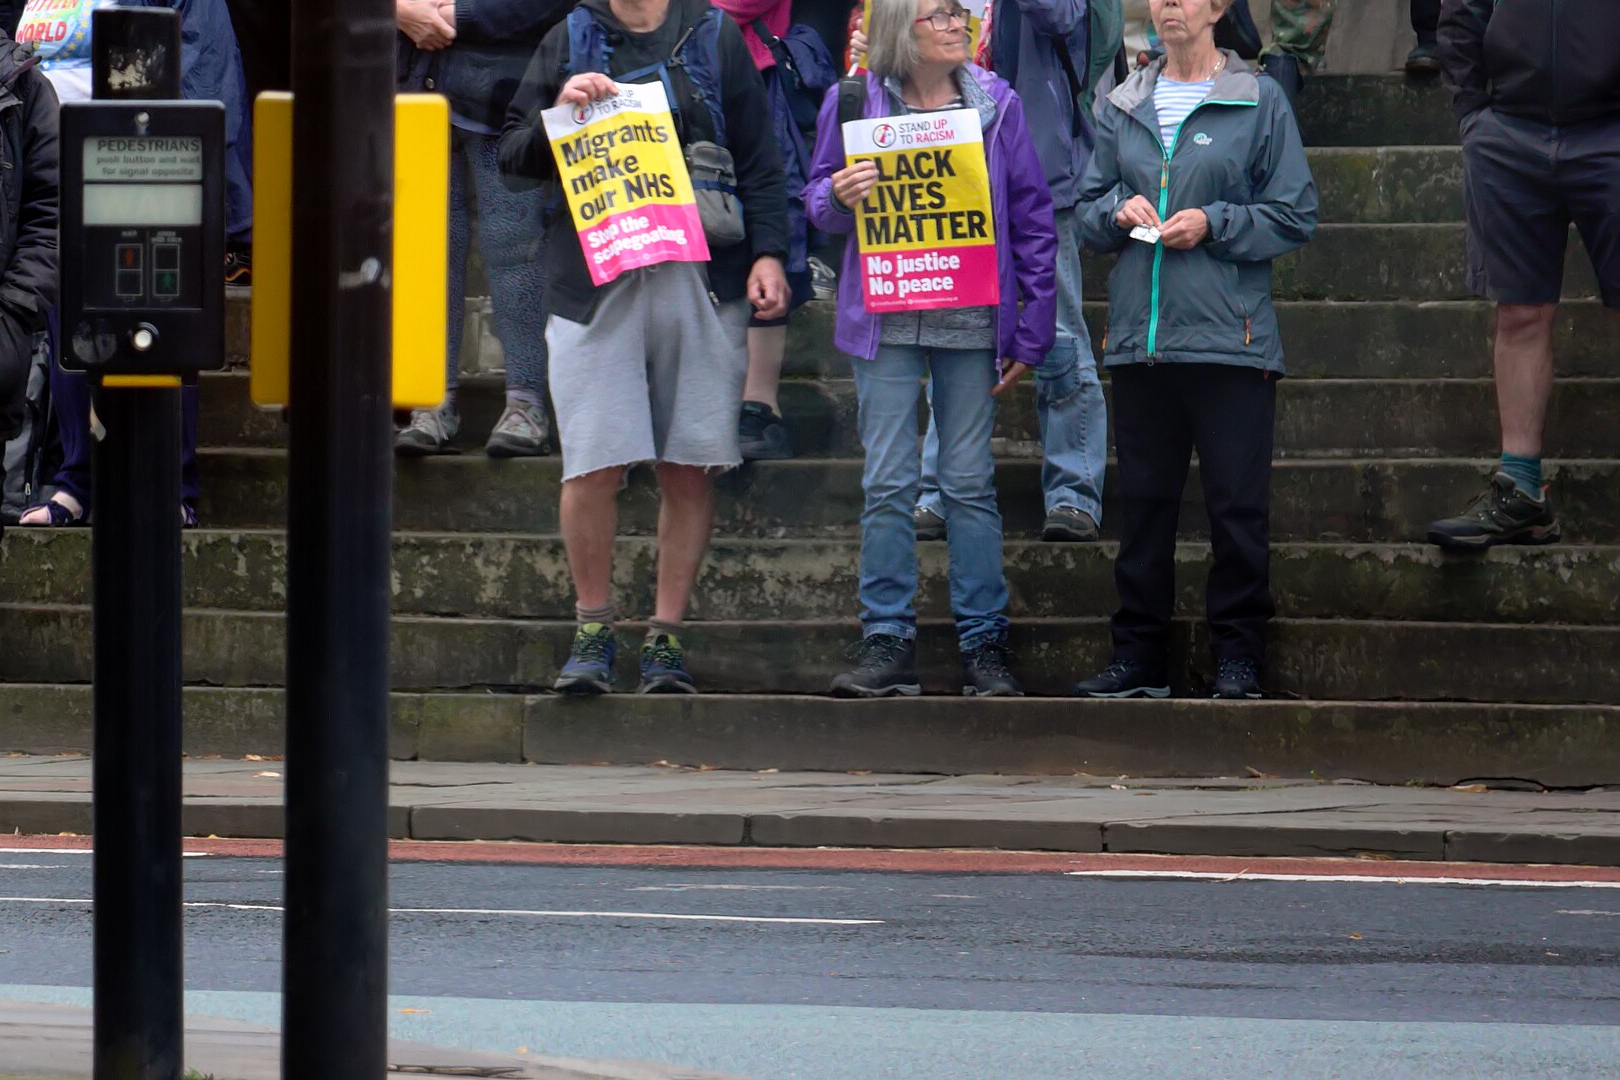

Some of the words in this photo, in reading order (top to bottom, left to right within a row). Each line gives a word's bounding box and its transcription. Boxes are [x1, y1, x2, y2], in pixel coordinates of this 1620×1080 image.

[899, 121, 931, 134] STAND
[934, 119, 948, 130] UP
[900, 135, 914, 145] TO
[916, 129, 955, 143] RACISM
[97, 139, 200, 152] PEDESTRIANS
[560, 120, 669, 167] Migrants
[123, 155, 156, 164] button
[855, 149, 956, 182] LACK
[571, 155, 639, 195] make
[580, 189, 618, 220] our
[623, 173, 675, 202] NHS
[587, 223, 619, 248] Stop
[620, 216, 650, 233] the
[865, 210, 988, 245] MATTER
[867, 256, 893, 275] No
[896, 252, 960, 277] justice
[869, 278, 894, 296] No
[898, 275, 954, 297] peace
